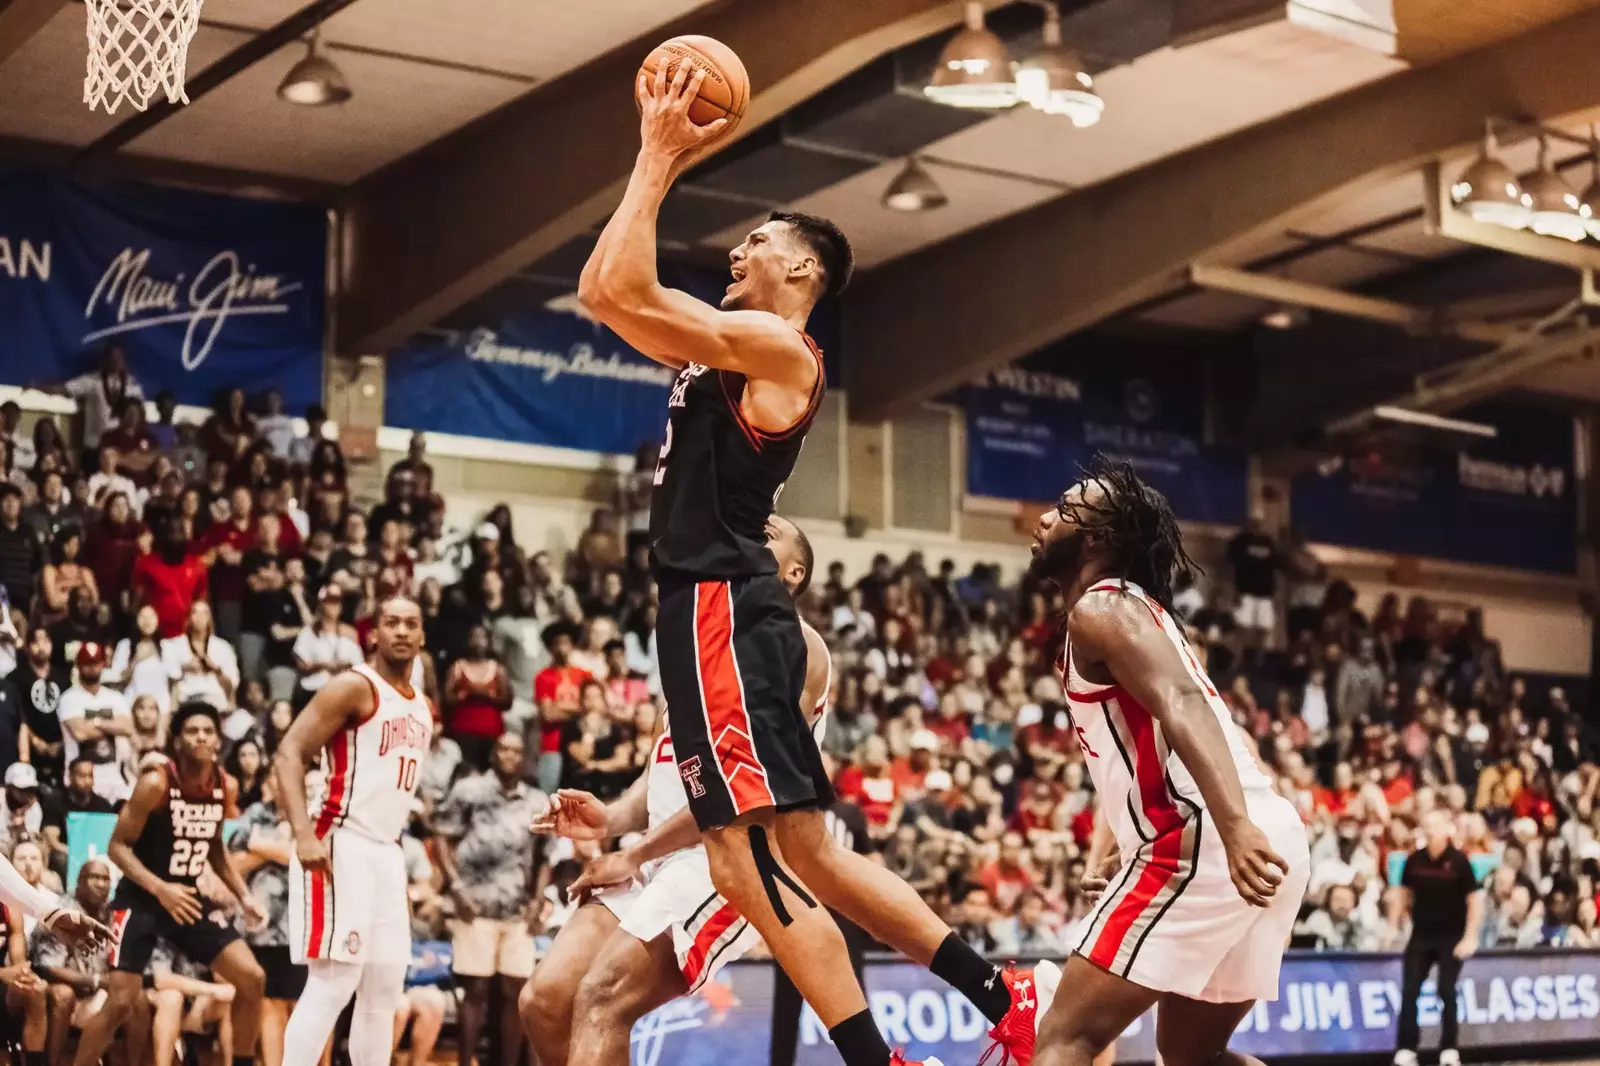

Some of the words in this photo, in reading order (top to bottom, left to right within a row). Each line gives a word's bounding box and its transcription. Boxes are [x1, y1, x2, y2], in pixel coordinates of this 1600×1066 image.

[701, 64, 723, 84] MAUI
[85, 248, 186, 322] Maui
[184, 250, 303, 371] Jim
[397, 755, 417, 792] 10
[169, 839, 209, 877] 22
[1279, 980, 1353, 1031] JIM
[1357, 973, 1599, 1029] EELASSES
